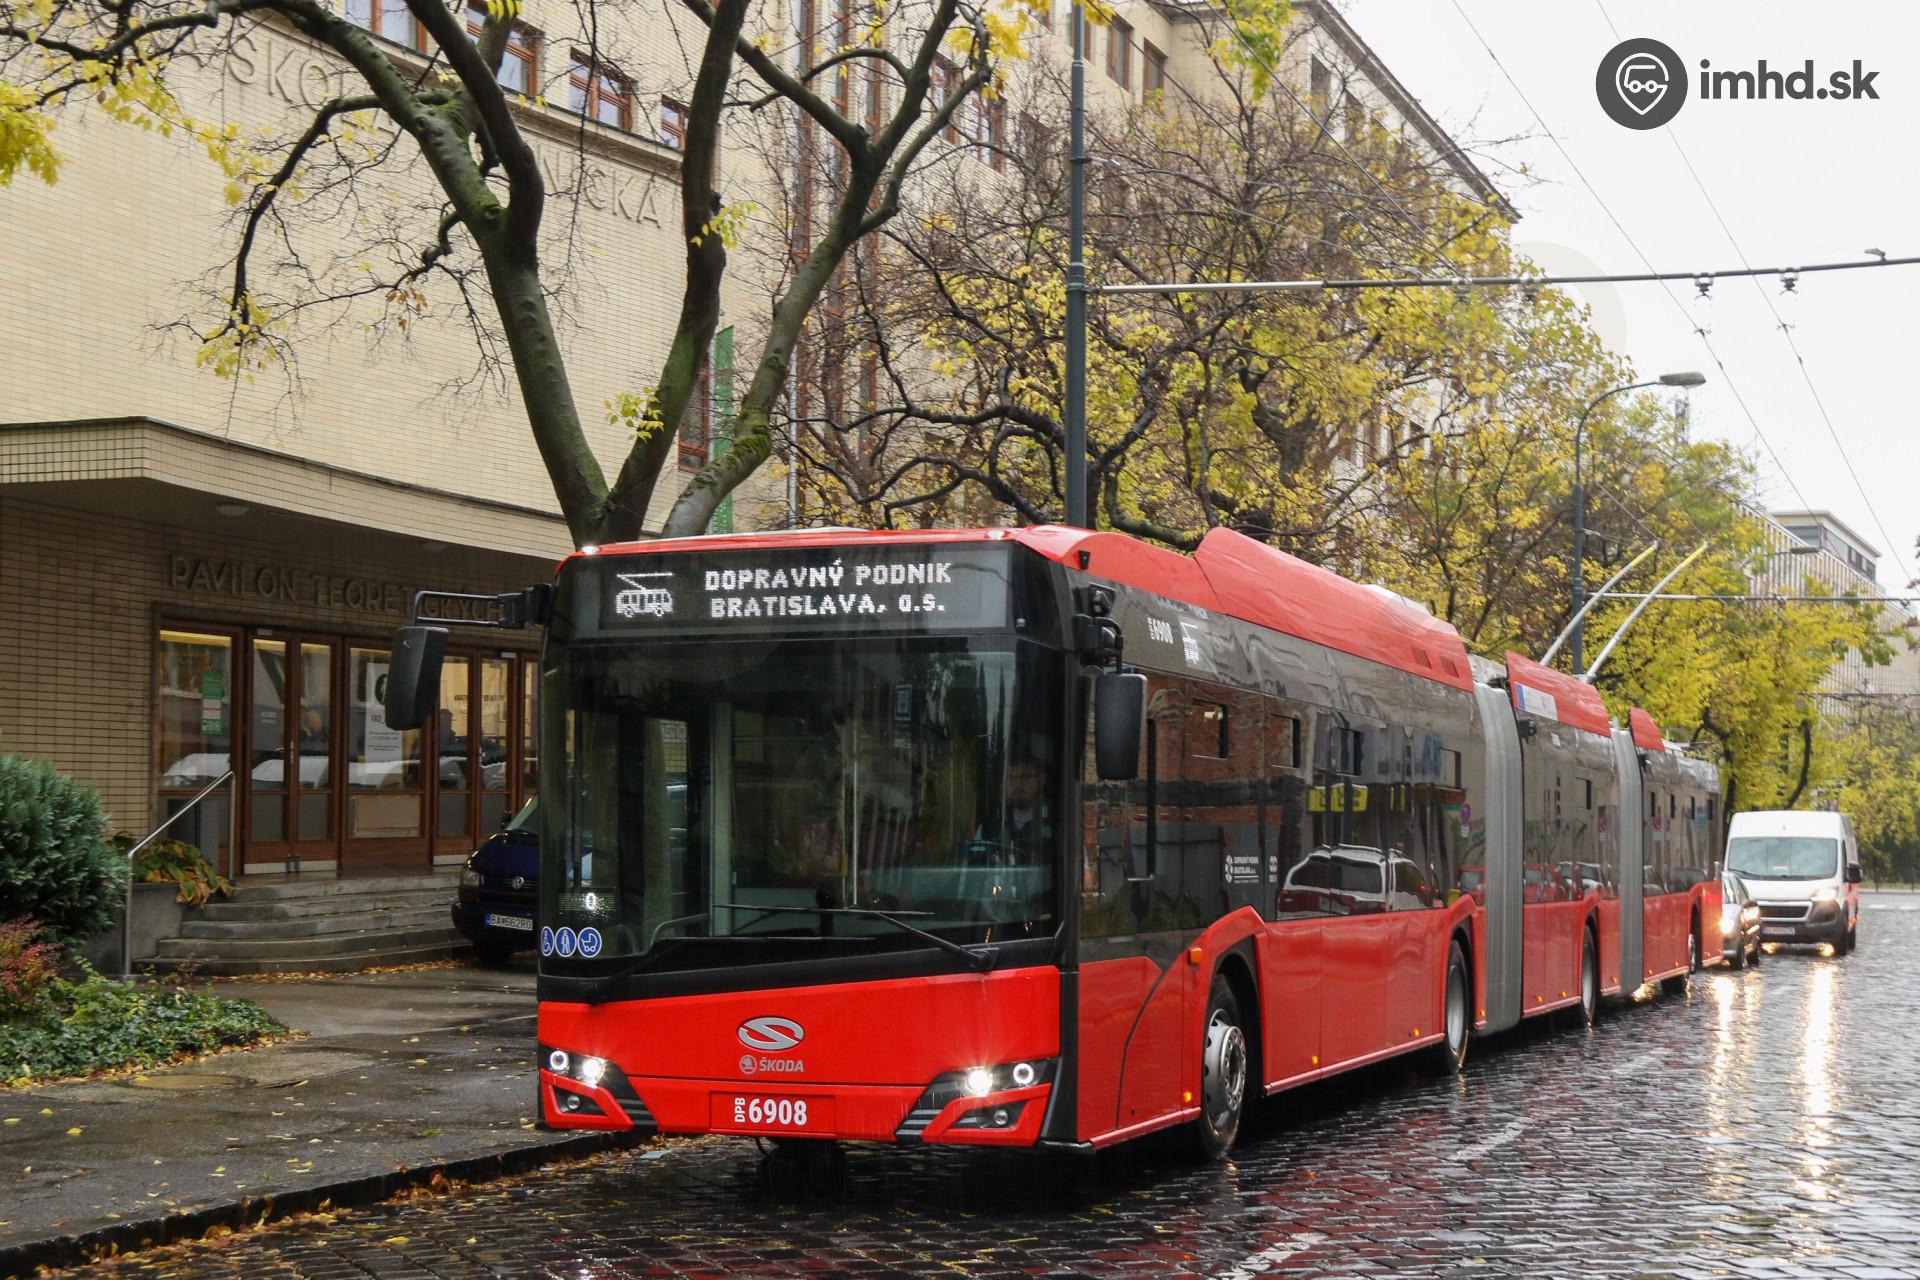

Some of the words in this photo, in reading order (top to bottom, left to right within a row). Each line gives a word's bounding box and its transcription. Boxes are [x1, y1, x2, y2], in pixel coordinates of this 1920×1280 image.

[170, 553, 297, 601] PAVILON
[704, 557, 845, 591] DOPRAVNÝ
[855, 562, 952, 586] PODNIK
[710, 593, 888, 619] BRATISLAVA,
[759, 1056, 804, 1072] ŠKODA
[734, 1097, 746, 1123] DPB
[748, 1098, 808, 1126] 6908
